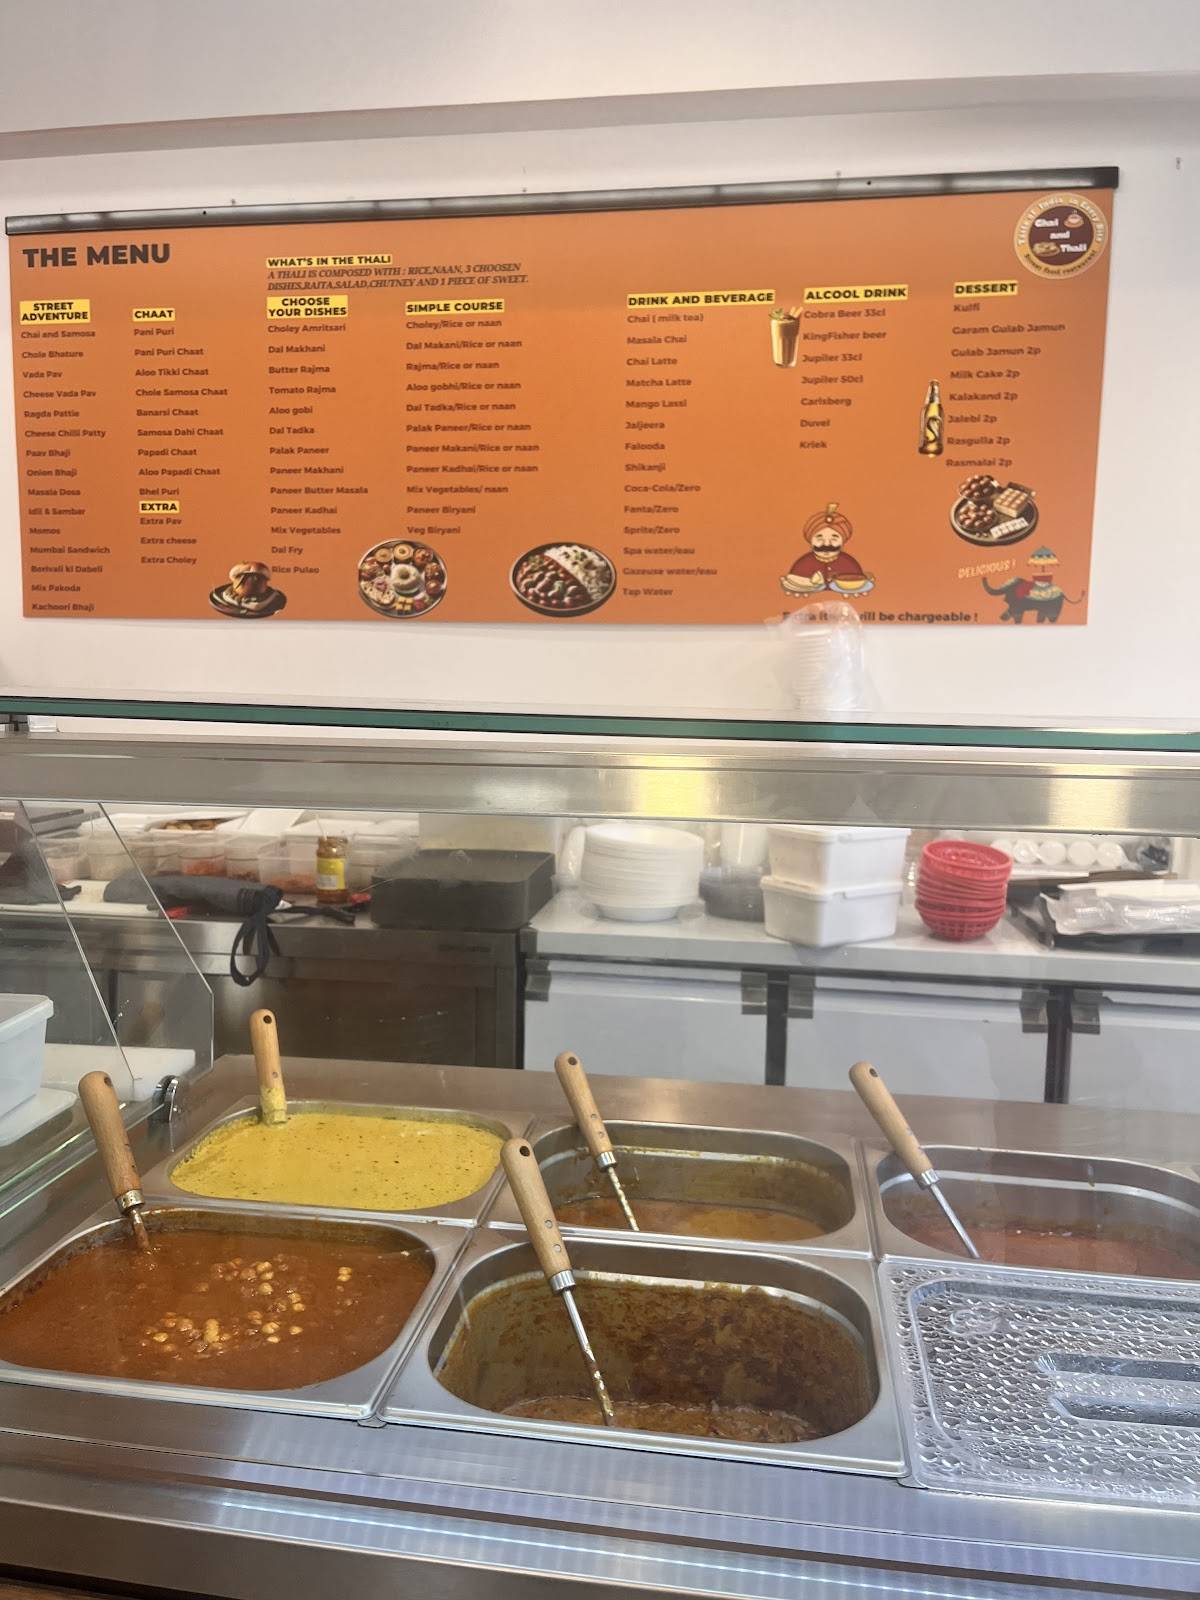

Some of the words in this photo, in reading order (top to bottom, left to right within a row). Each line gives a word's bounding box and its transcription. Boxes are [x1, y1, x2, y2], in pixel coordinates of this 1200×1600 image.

[1034, 218, 1059, 228] Chai
[23, 247, 76, 267] THE
[87, 243, 170, 265] MENU
[268, 258, 313, 266] WHAT'S
[955, 283, 1017, 294] DESSERT
[806, 290, 859, 300] ALCOOL
[865, 288, 906, 298] DRINK
[282, 297, 329, 306] CHOOSE
[628, 296, 668, 306] DRINK
[673, 295, 700, 304] AND
[704, 293, 773, 303] BEVERAGE
[33, 302, 73, 310] STREET
[407, 304, 450, 312] SIMPLE
[454, 302, 503, 311] COURSE
[135, 310, 173, 318] CHAAT
[305, 307, 346, 316] DISHES
[21, 312, 88, 321] ADVENTURE
[664, 335, 687, 343] Chai
[863, 331, 886, 339] beer
[286, 344, 325, 352] Makhani
[406, 342, 422, 350] Dal
[135, 348, 154, 356] Pani
[627, 358, 649, 366] Chai
[300, 365, 330, 374] Rajma
[307, 385, 336, 394] Rajma
[626, 401, 660, 409] Mango
[801, 397, 851, 406] Carlsberg
[292, 407, 313, 415] gobi
[800, 419, 830, 427] Duvel
[82, 430, 105, 438] Patty
[55, 469, 77, 477] Bhaji
[141, 503, 177, 511] EXTRA
[442, 506, 476, 515] Biryani
[289, 527, 341, 535] Vegetables
[72, 604, 94, 612] Bhaji
[879, 612, 895, 621] be
[898, 612, 971, 623] chargeable
